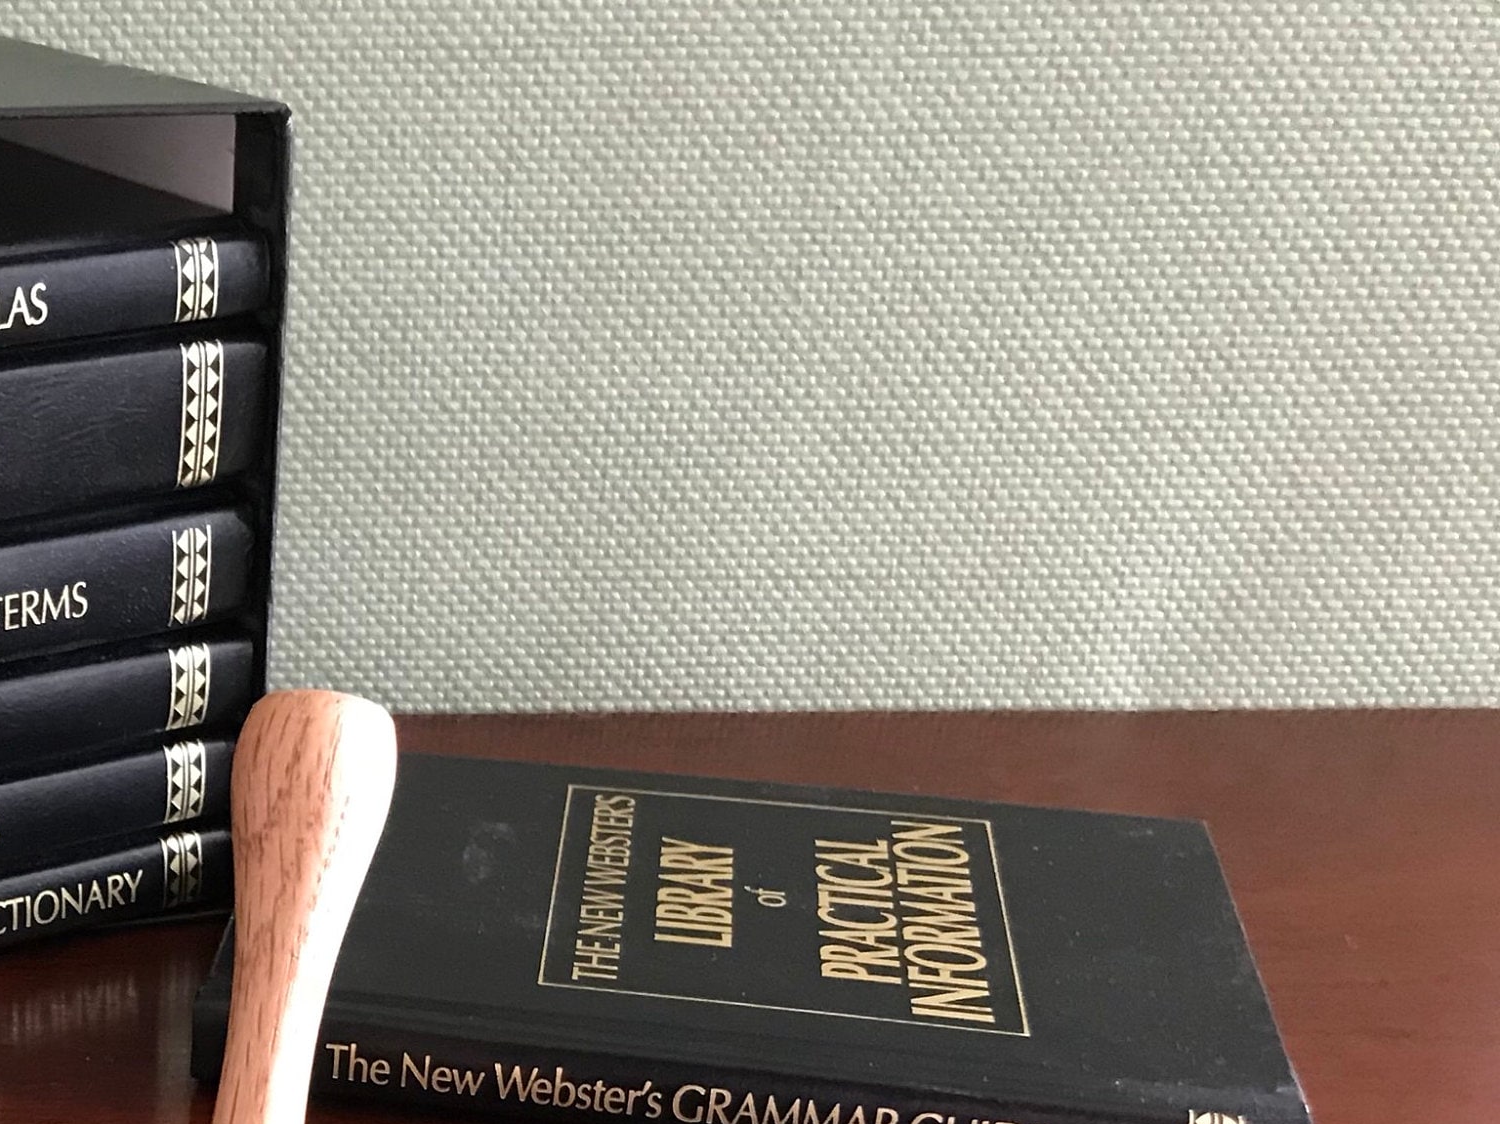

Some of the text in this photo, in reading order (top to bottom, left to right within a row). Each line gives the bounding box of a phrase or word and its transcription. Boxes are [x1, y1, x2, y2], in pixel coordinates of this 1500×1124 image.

[576, 885, 625, 939] NEW
[653, 836, 734, 948] LIBRARY
[743, 885, 787, 908] of
[814, 838, 903, 985] PRACTICAL
[890, 819, 996, 1023] INFORMATION
[571, 938, 621, 981] THE
[325, 1042, 391, 1085] The
[400, 1051, 486, 1096] New
[494, 1062, 663, 1119] Webster's
